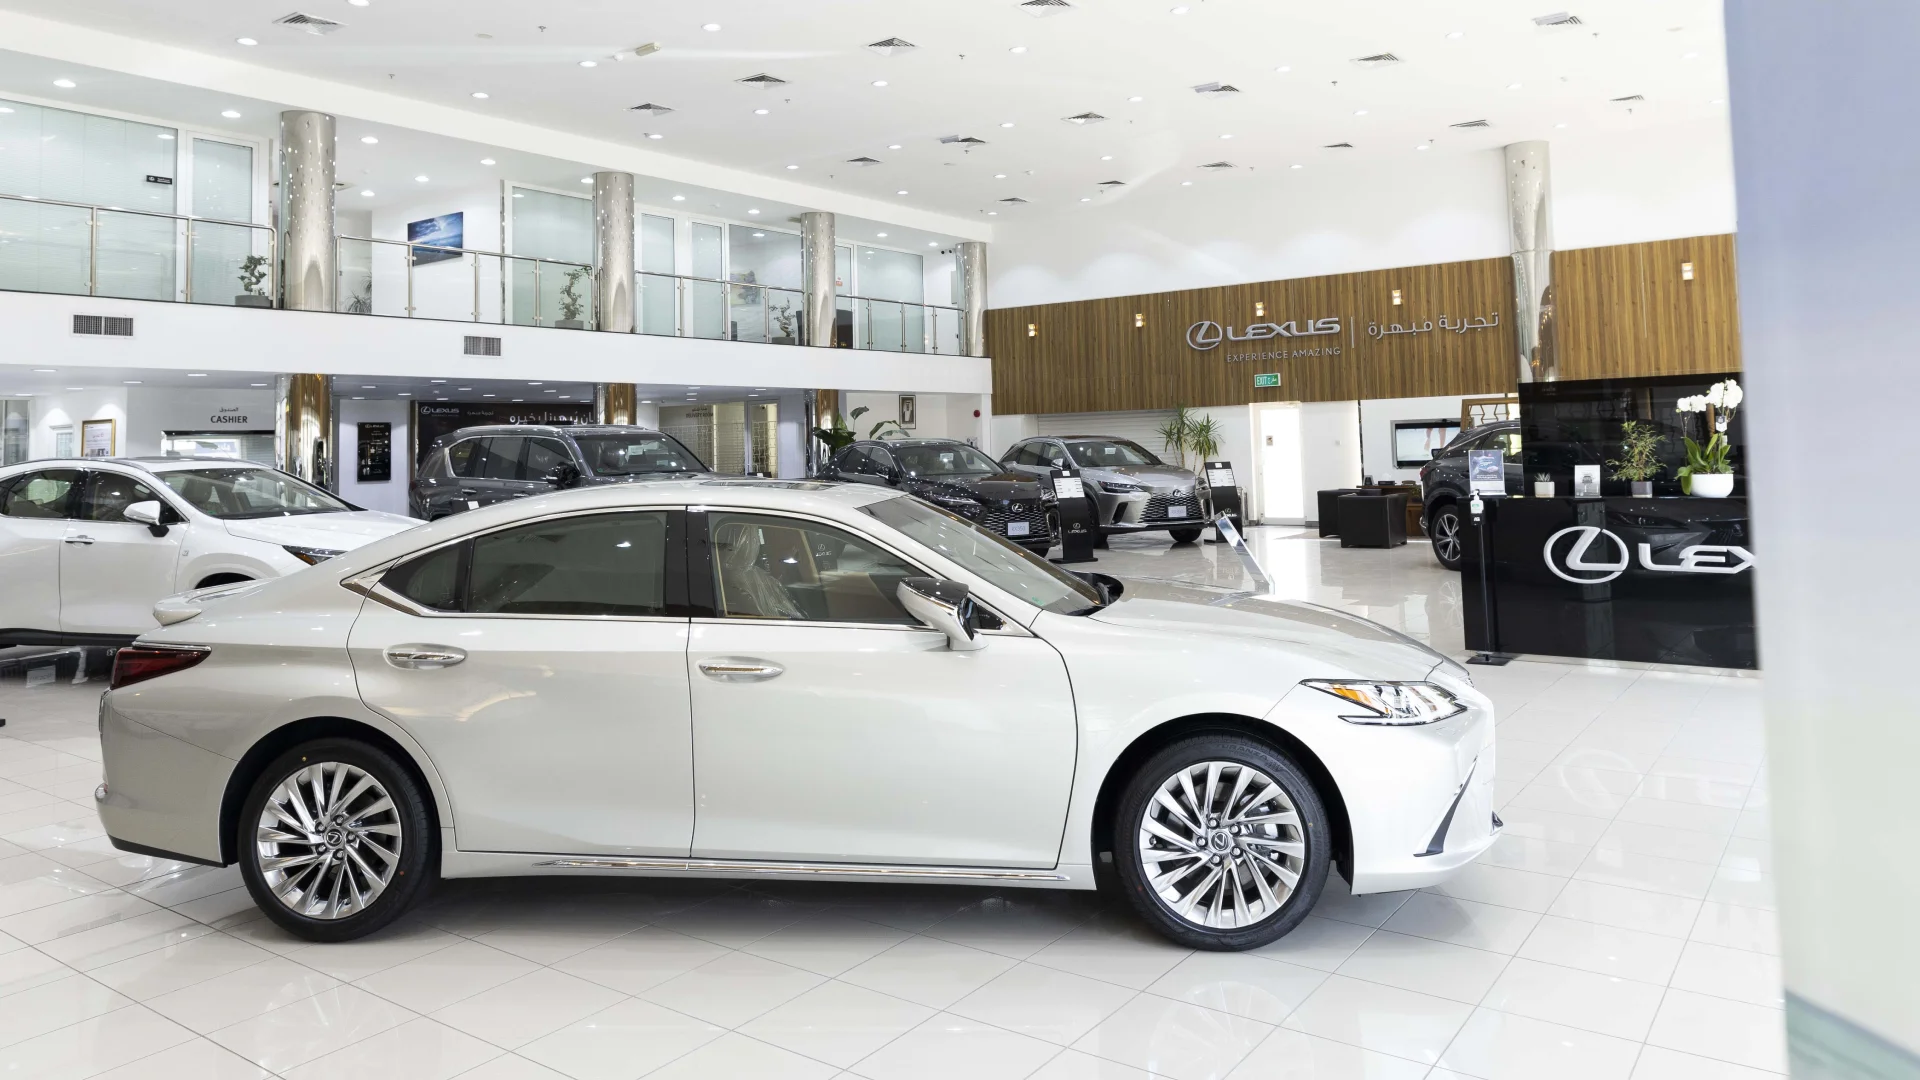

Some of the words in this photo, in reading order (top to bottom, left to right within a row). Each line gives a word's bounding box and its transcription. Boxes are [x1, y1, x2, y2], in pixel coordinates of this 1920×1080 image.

[1226, 317, 1341, 341] LEXUS
[1438, 312, 1499, 334] تجربة
[1226, 351, 1288, 363] EXPERIENCE
[1292, 347, 1341, 359] AMAZING
[1256, 376, 1267, 386] EXIT
[210, 415, 248, 423] CASHIER
